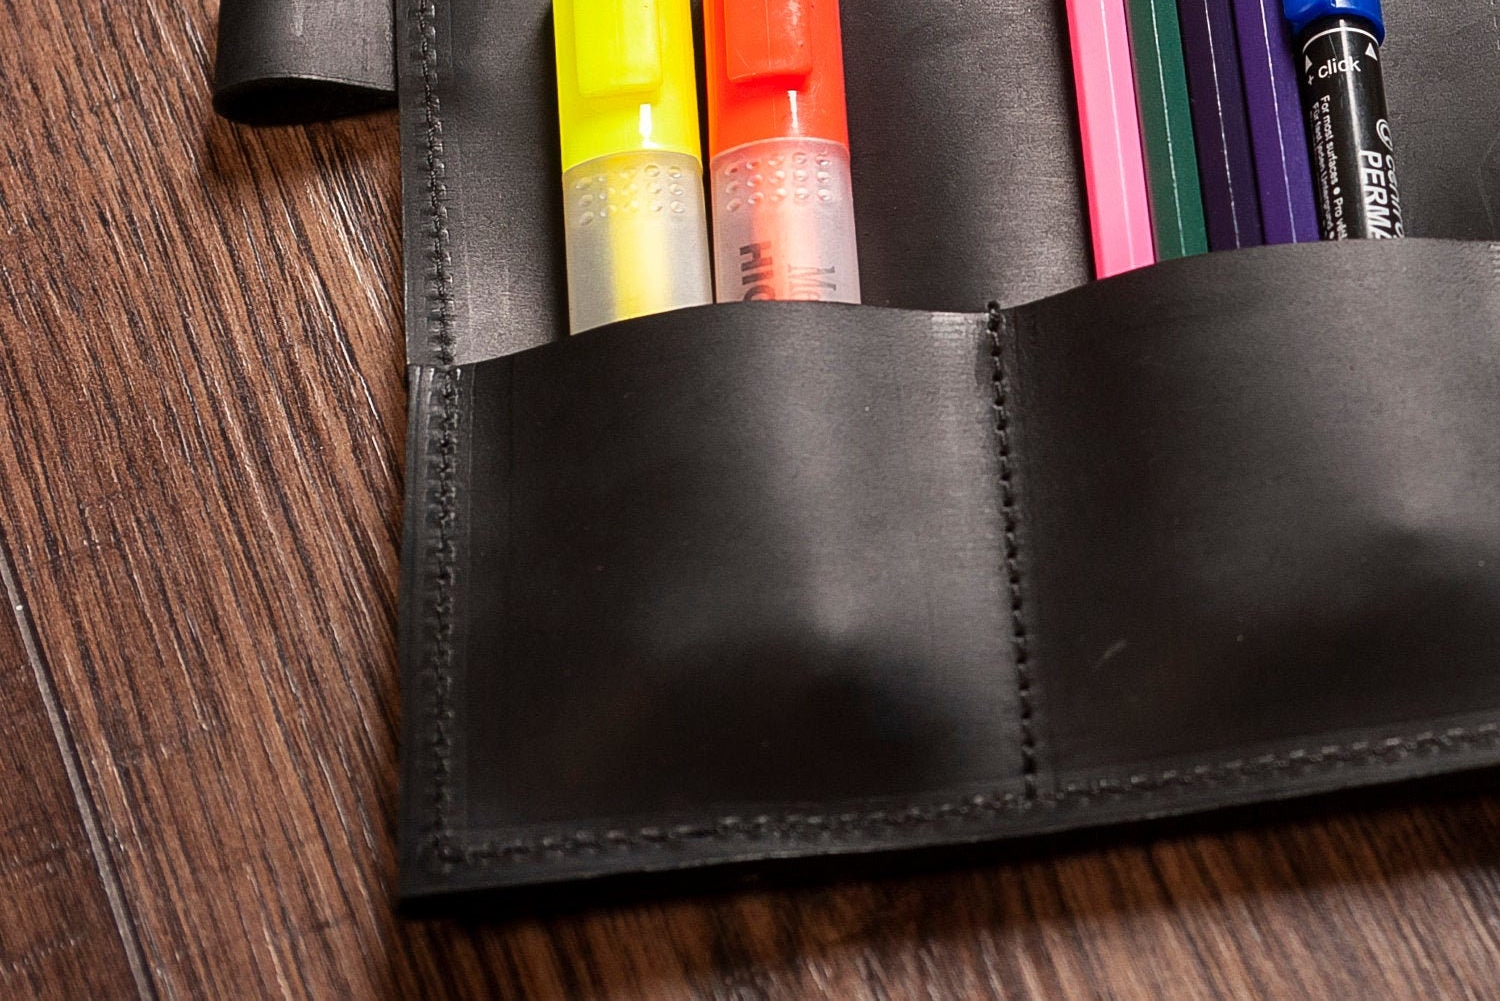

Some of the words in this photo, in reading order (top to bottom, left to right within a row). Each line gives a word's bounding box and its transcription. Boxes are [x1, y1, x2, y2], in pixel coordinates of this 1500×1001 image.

[1318, 55, 1361, 78] click
[1320, 94, 1330, 113] For
[1323, 114, 1334, 141] most
[1326, 141, 1338, 185] surfaces
[1333, 197, 1344, 218] Pro
